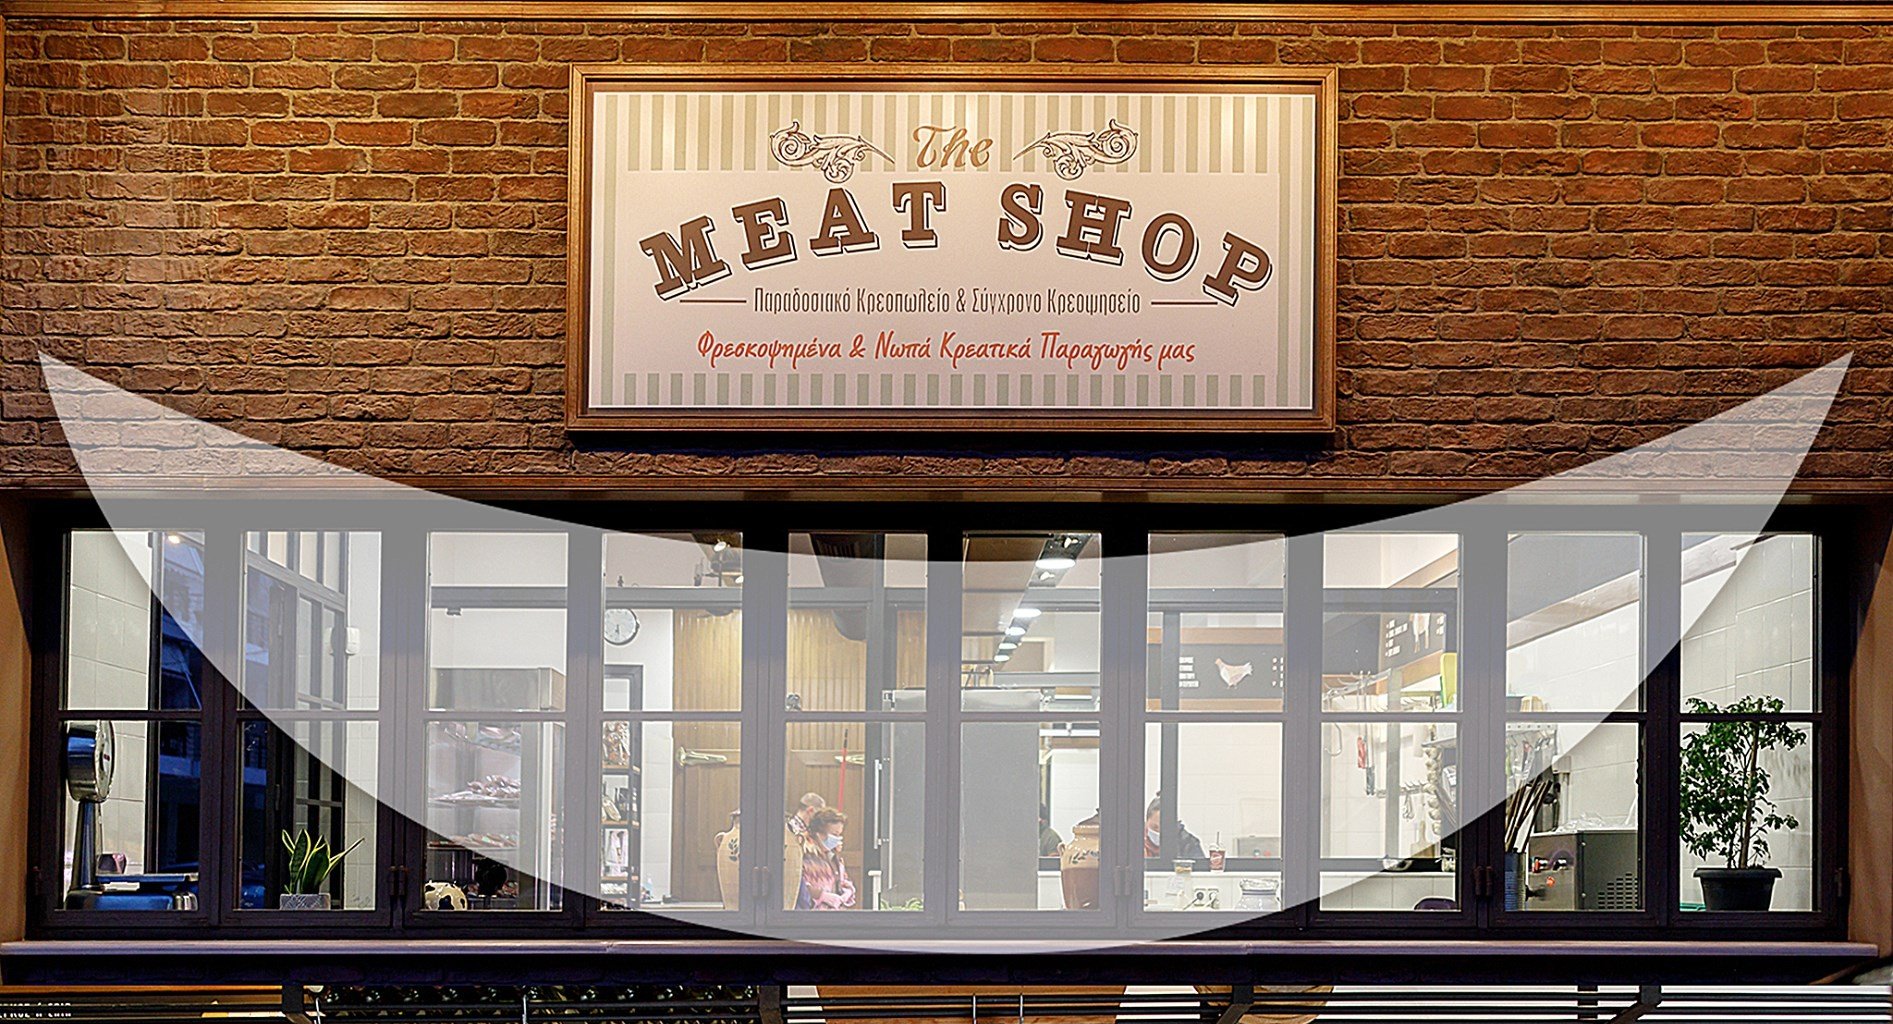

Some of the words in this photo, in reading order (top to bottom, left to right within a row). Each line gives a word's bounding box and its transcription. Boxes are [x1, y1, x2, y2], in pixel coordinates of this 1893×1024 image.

[912, 124, 994, 169] The
[639, 181, 946, 300] MEAT
[998, 183, 1273, 307] SHOP
[754, 287, 851, 315] Παραδοσιακό
[857, 287, 950, 315] Κρεοπωλείο
[956, 287, 966, 313] &
[972, 287, 1042, 315] Σύγχρονο
[1047, 288, 1141, 316] Κρεοψησείο
[697, 330, 842, 370] Φρεσκοψημένα
[849, 334, 866, 358] &
[874, 330, 932, 360] Νωπά
[939, 331, 1031, 370] Κρεατικά
[1041, 331, 1153, 371] Παραγωγής
[1157, 344, 1196, 371] μας
